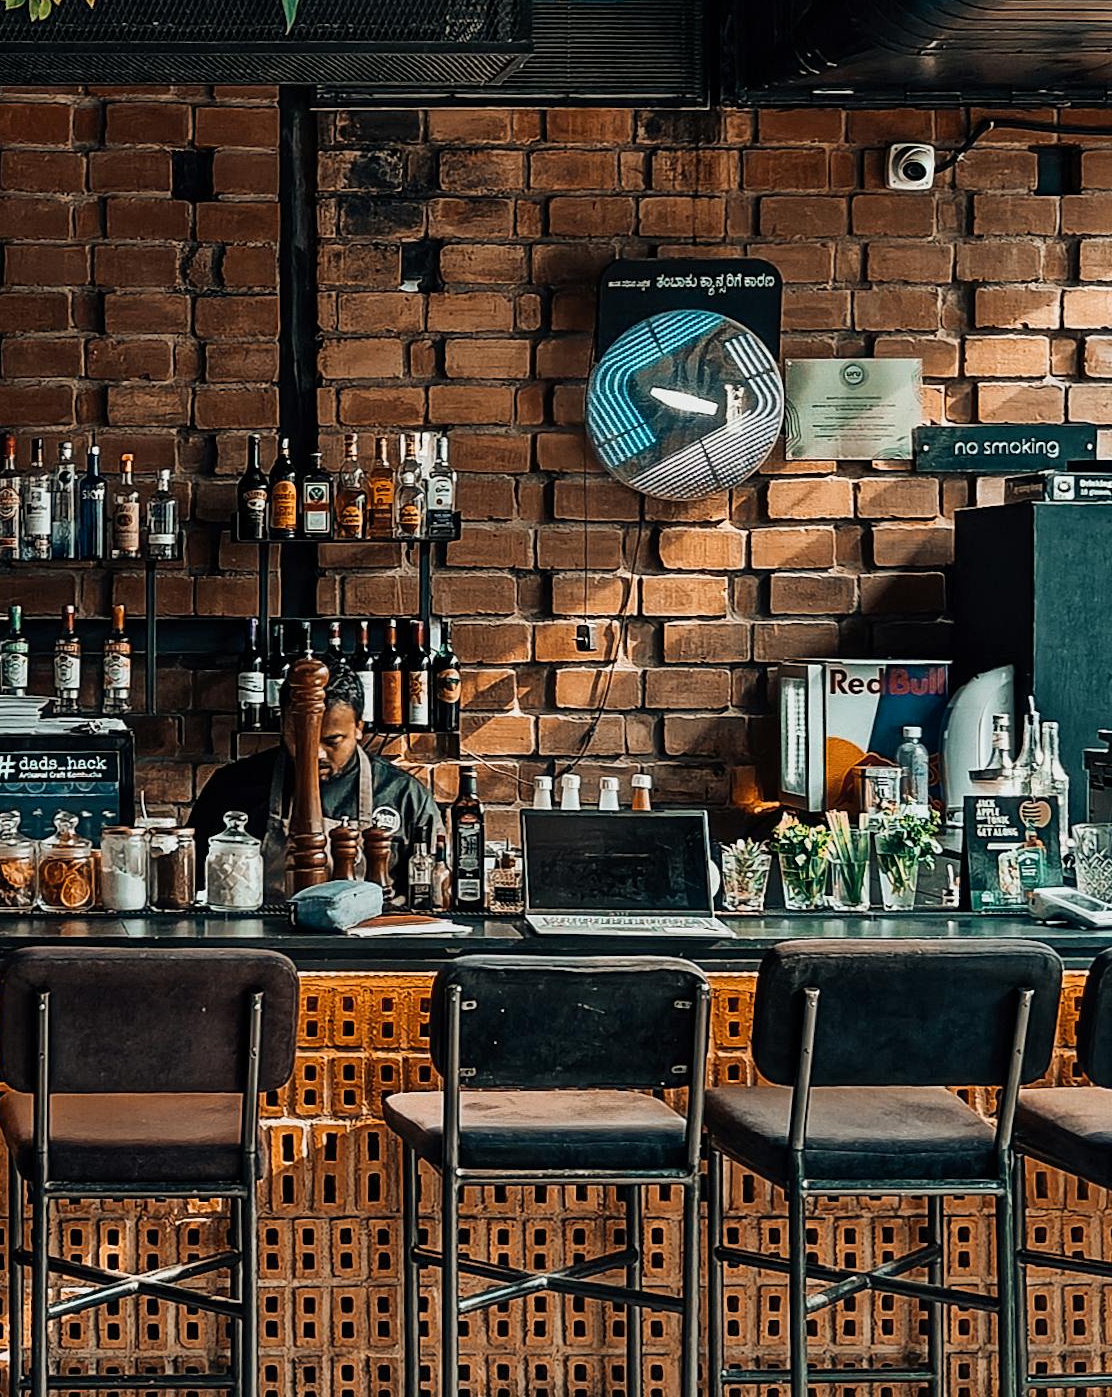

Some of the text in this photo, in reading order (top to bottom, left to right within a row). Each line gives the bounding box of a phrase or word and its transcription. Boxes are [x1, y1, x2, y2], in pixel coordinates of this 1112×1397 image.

[954, 437, 1060, 458] no smoking
[829, 667, 946, 695] Red Bull
